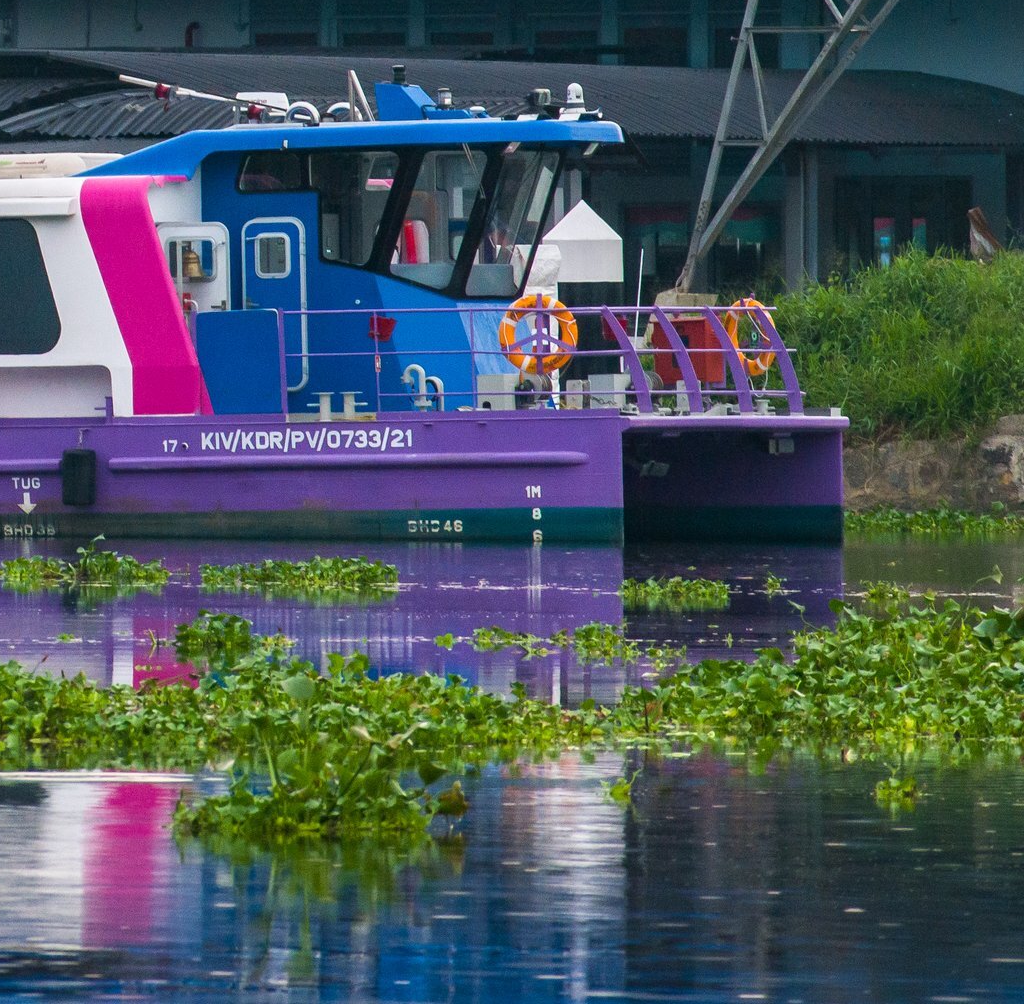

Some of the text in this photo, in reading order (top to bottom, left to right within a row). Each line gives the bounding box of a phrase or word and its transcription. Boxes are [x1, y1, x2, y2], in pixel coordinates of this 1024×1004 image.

[162, 439, 178, 453] 17
[201, 427, 413, 453] KIV/KDR/PV/0733/21
[11, 477, 41, 489] TUG
[525, 485, 541, 498] 1M
[532, 507, 542, 520] 8
